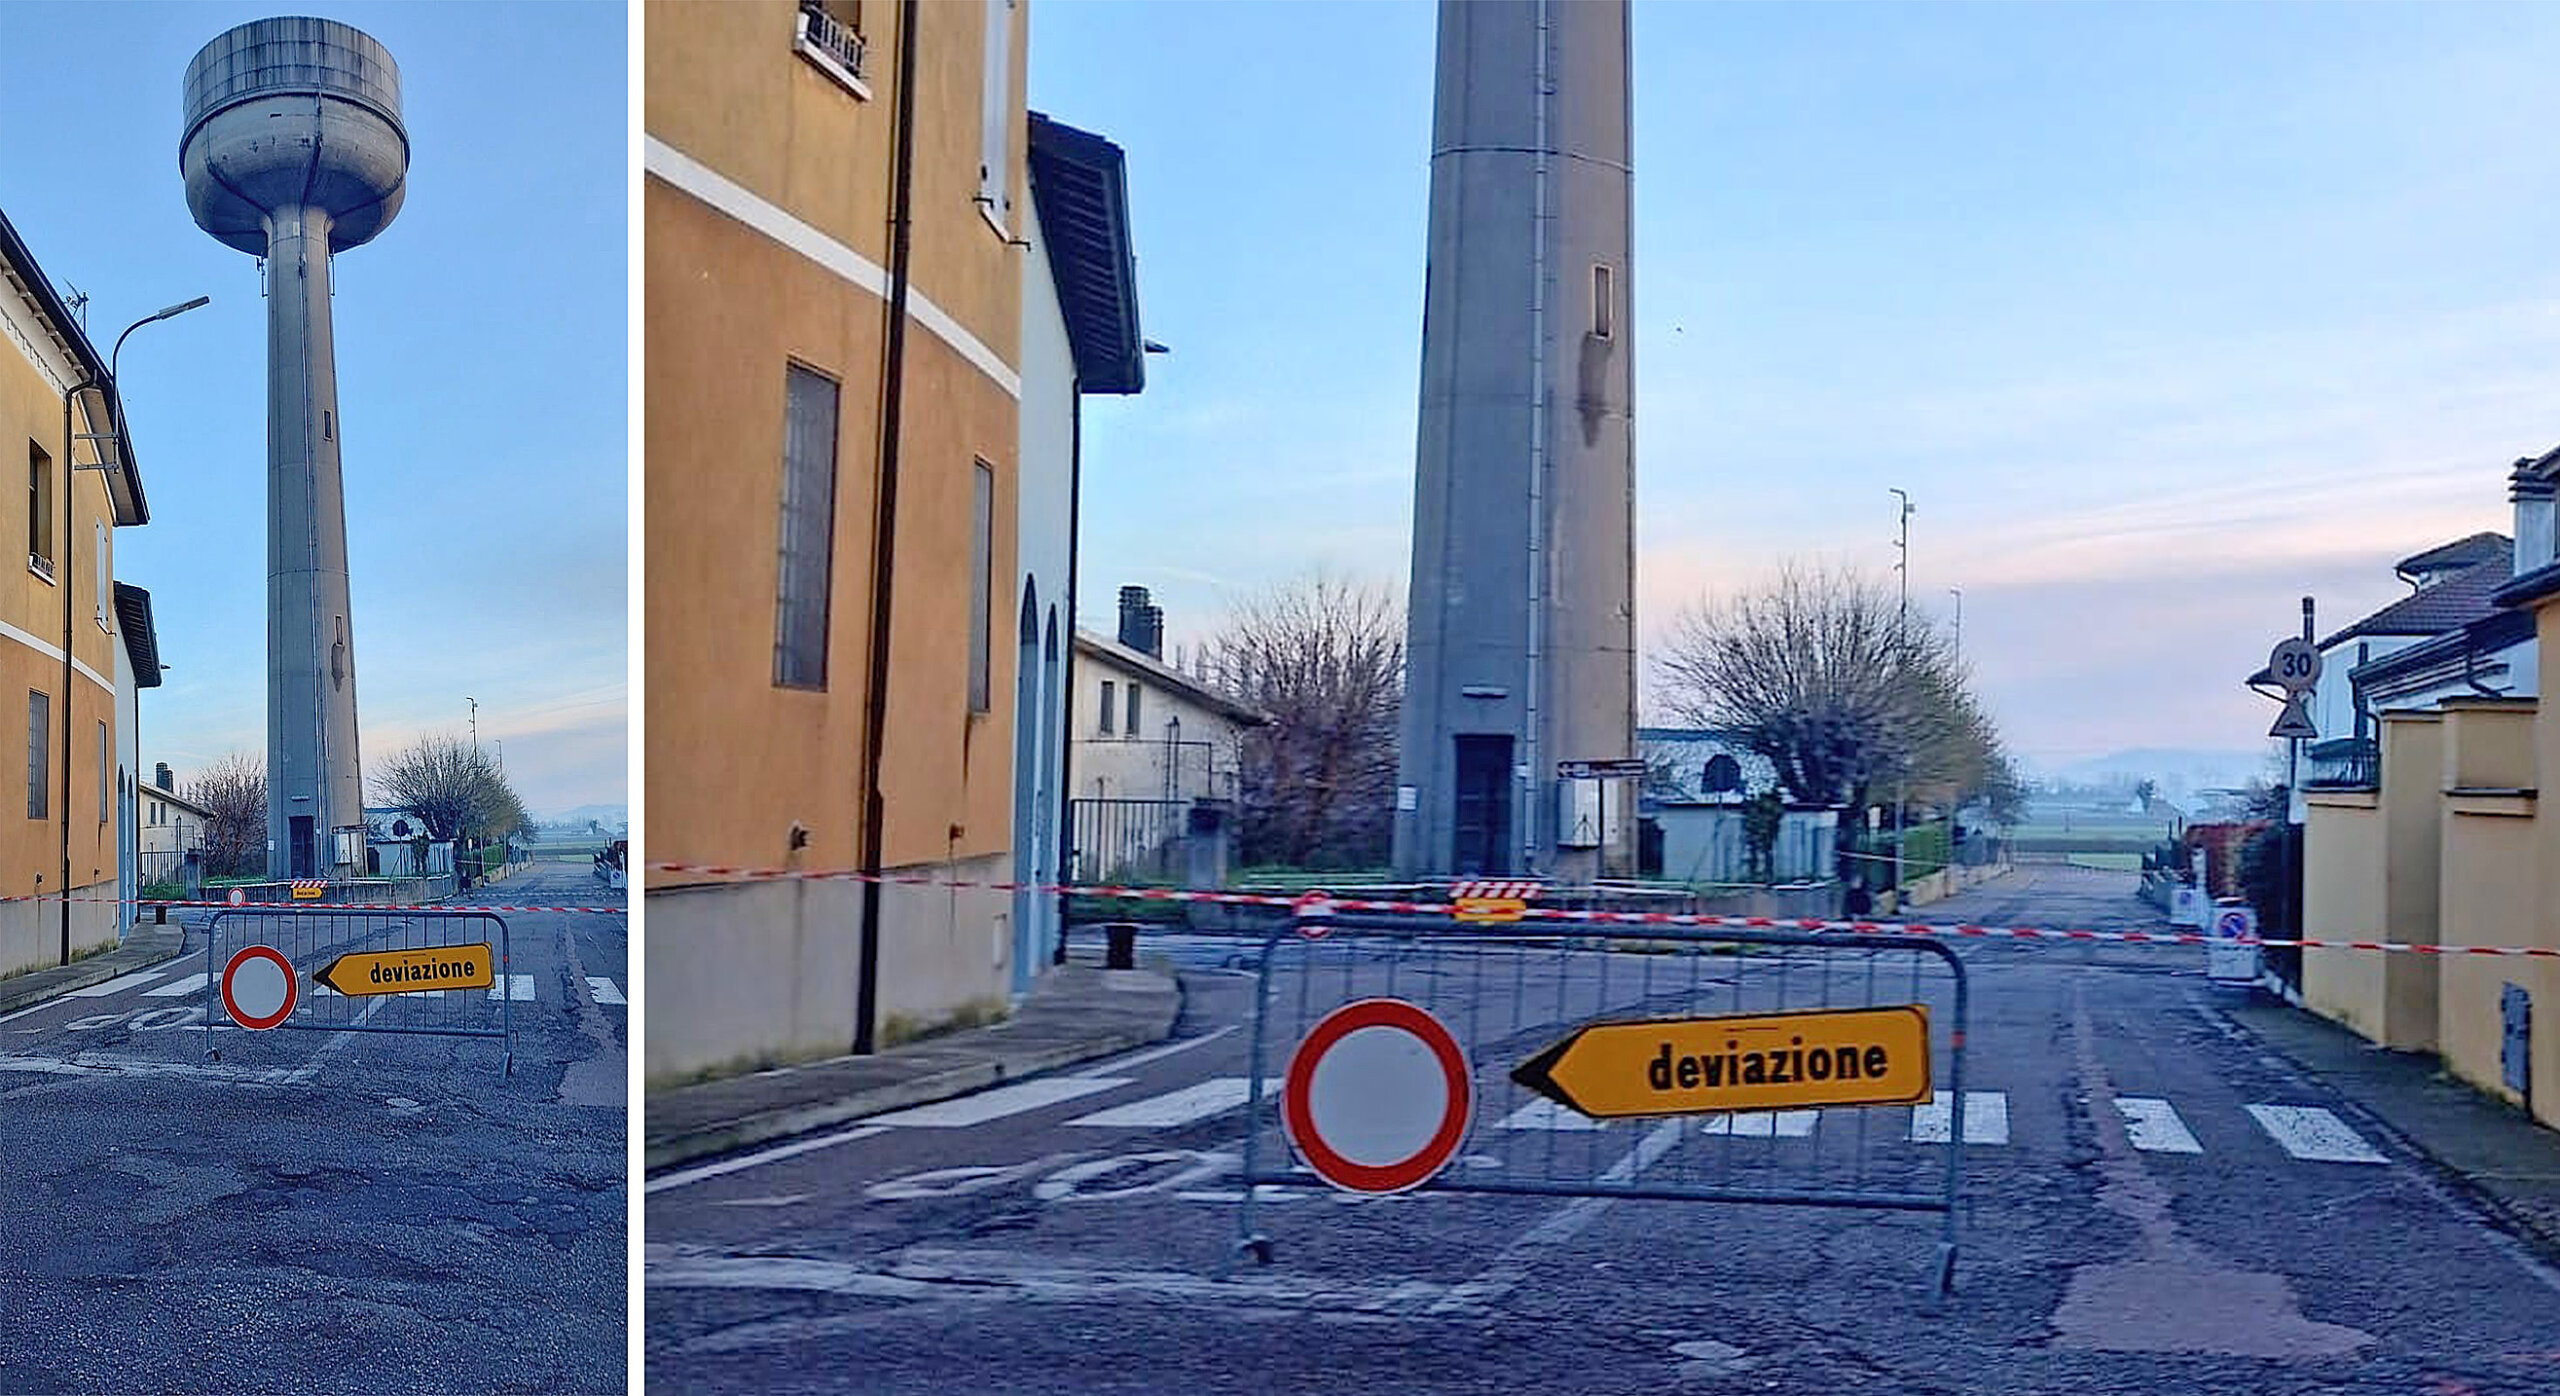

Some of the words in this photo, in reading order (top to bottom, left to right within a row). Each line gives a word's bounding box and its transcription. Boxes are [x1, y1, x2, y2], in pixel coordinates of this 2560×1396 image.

[2281, 652, 2312, 678] 30
[369, 957, 475, 984] deviazione
[1649, 1036, 1888, 1090] deviazione
